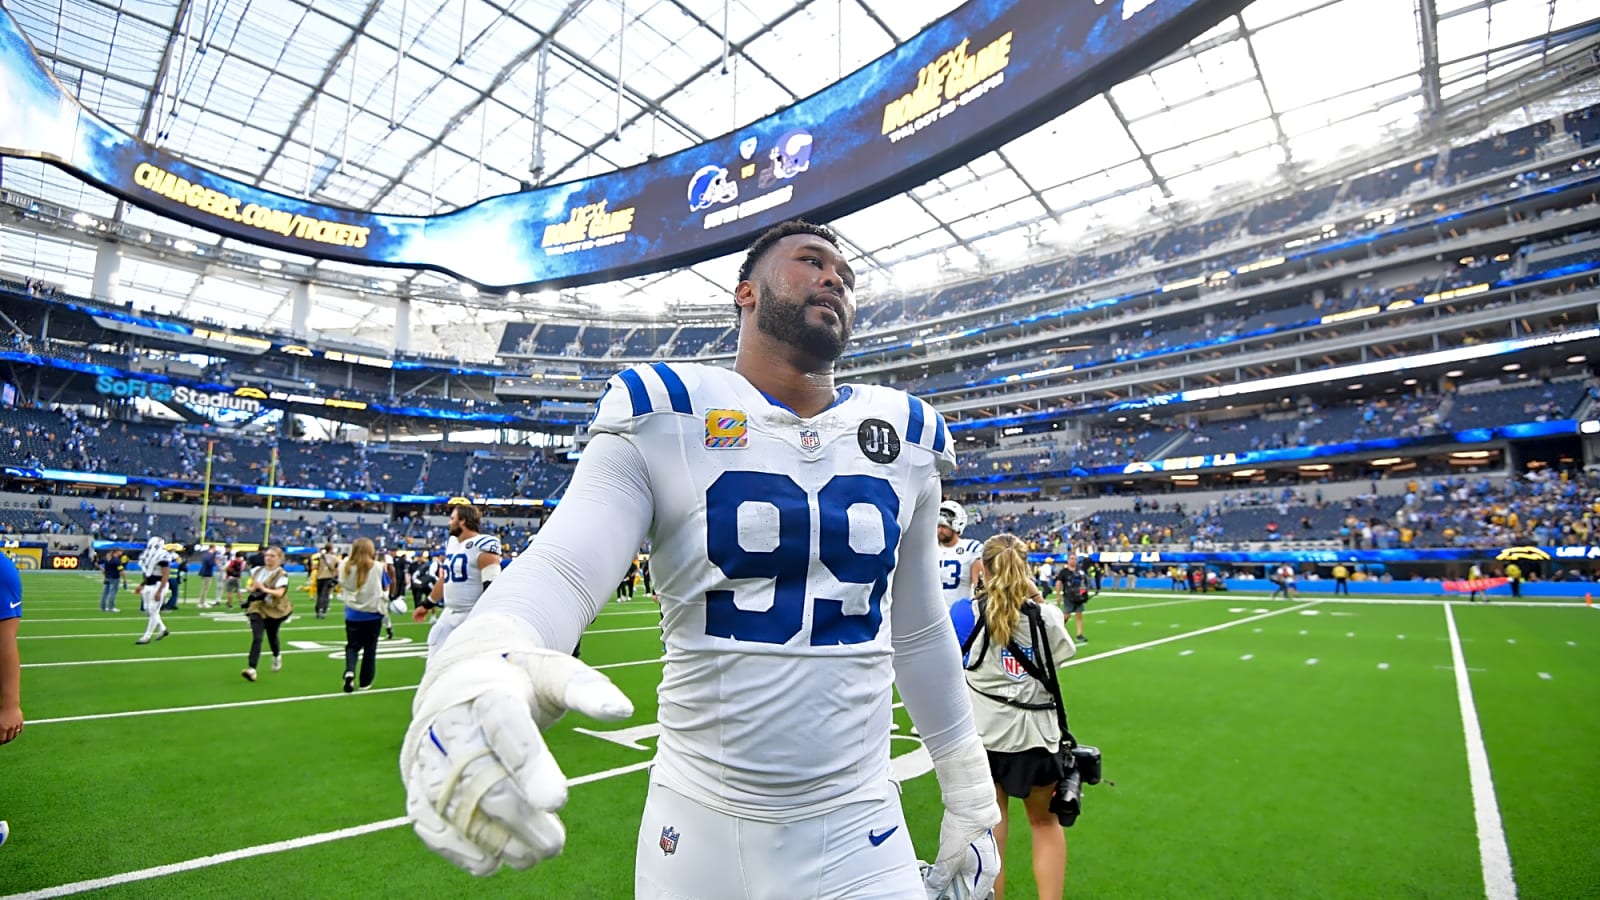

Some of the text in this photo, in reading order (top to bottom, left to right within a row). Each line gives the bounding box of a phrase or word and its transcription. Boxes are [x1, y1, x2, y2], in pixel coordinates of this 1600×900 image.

[882, 32, 1013, 135] HOME GAME
[134, 162, 370, 248] CHARGERS.COM/TICKETS
[96, 375, 147, 397] SoFi
[175, 386, 260, 413] Stadium
[803, 437, 818, 446] NFL
[53, 556, 78, 569] 0:00
[705, 471, 901, 646] 99
[939, 559, 962, 590] 3
[1004, 657, 1028, 676] NF
